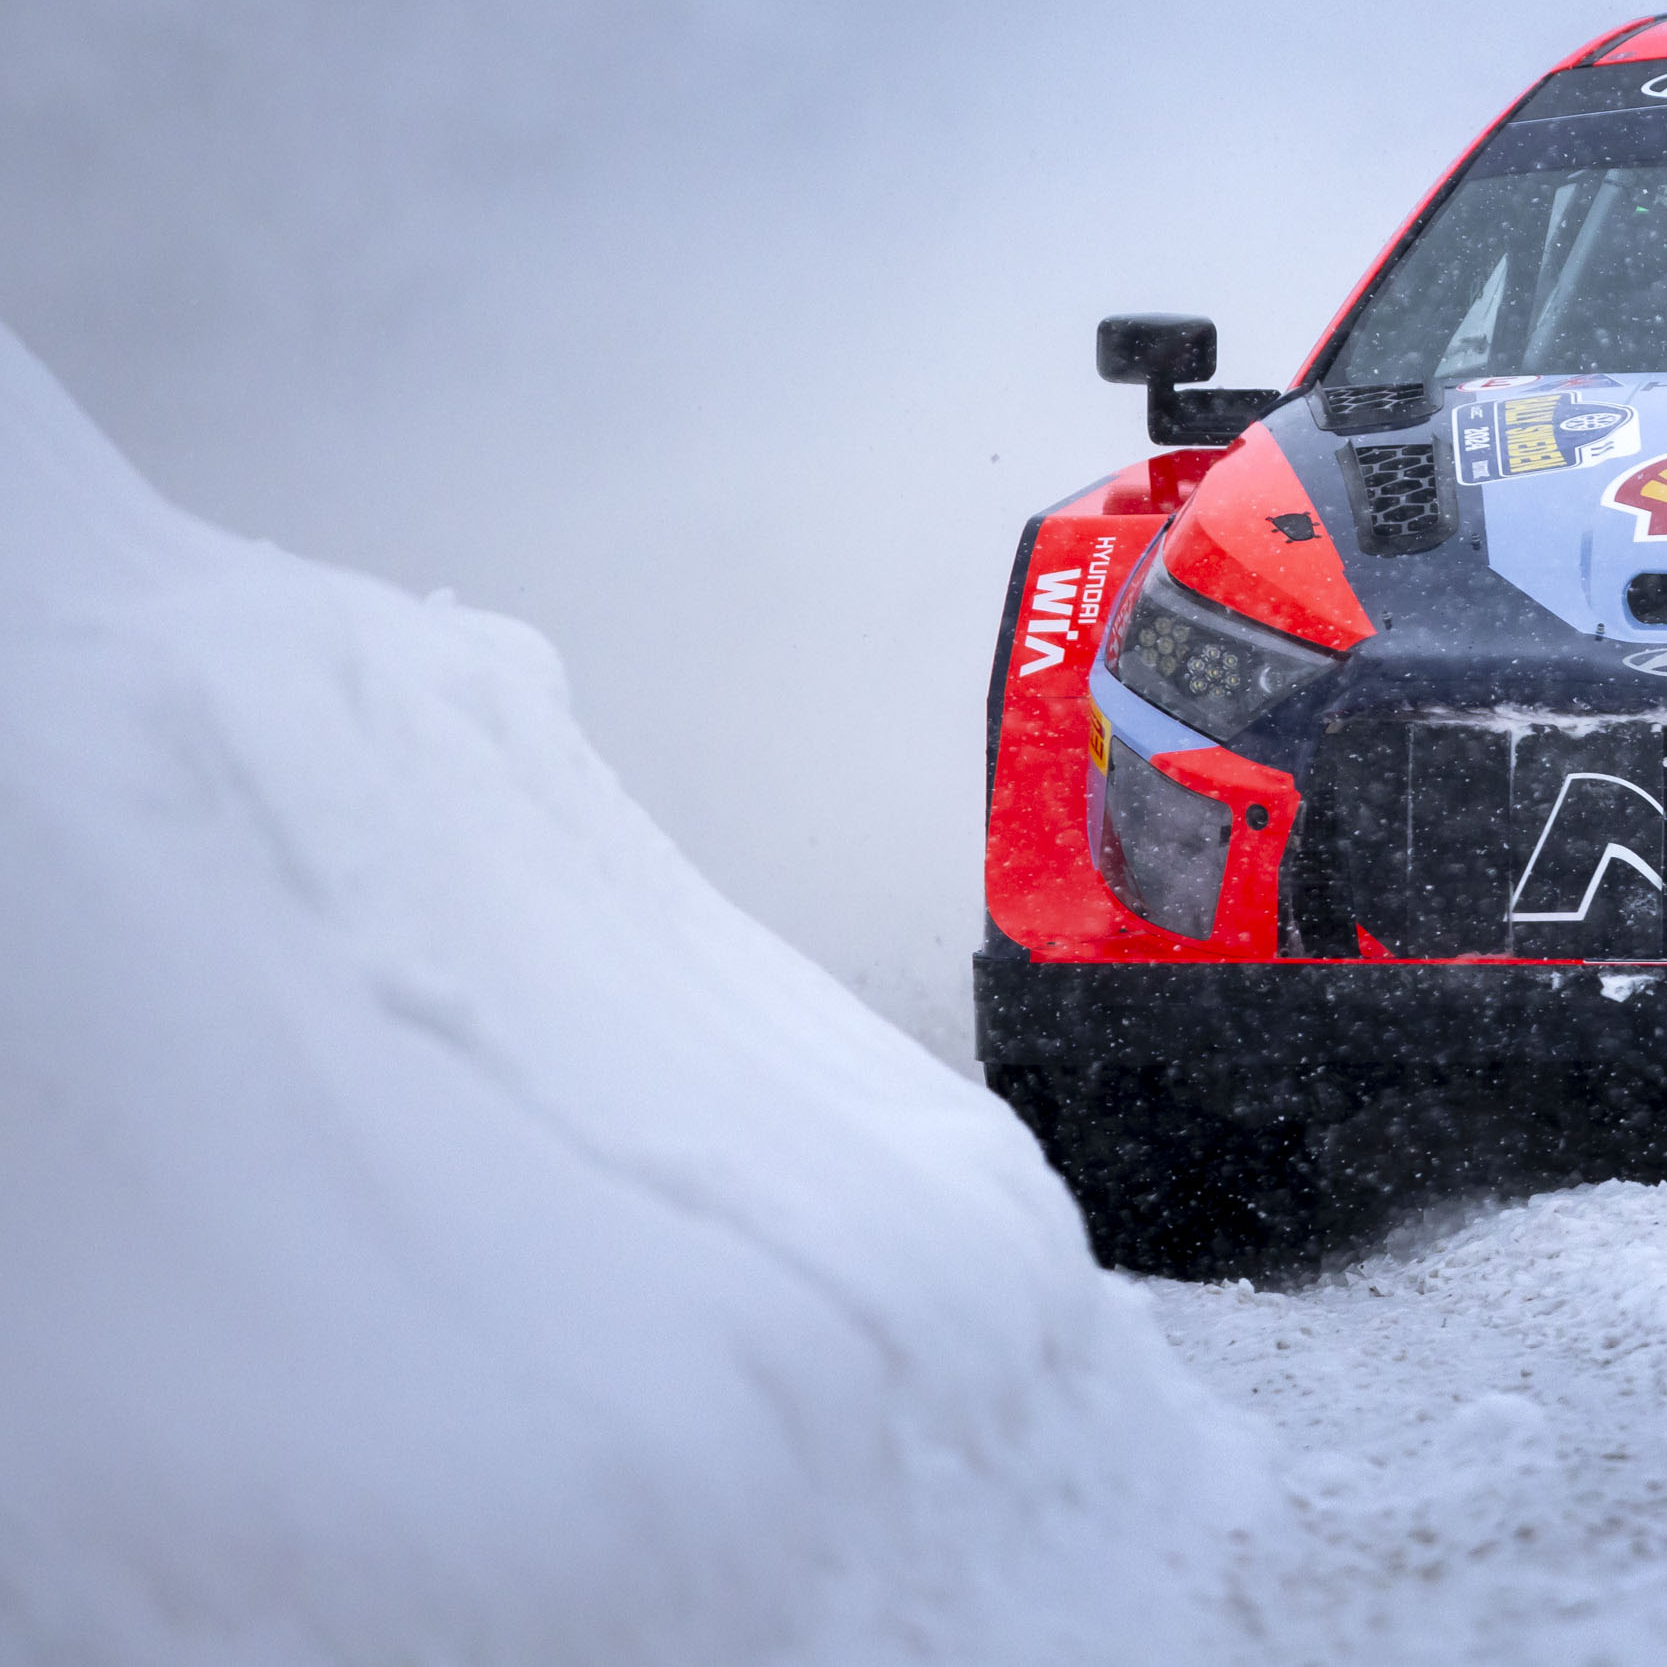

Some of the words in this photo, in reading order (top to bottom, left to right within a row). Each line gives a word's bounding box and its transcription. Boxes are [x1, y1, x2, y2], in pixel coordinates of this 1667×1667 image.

[1505, 394, 1562, 425] RALLY
[1464, 426, 1490, 452] 2024
[1505, 424, 1568, 473] SWEDEN
[1078, 537, 1116, 624] HYUNDAI
